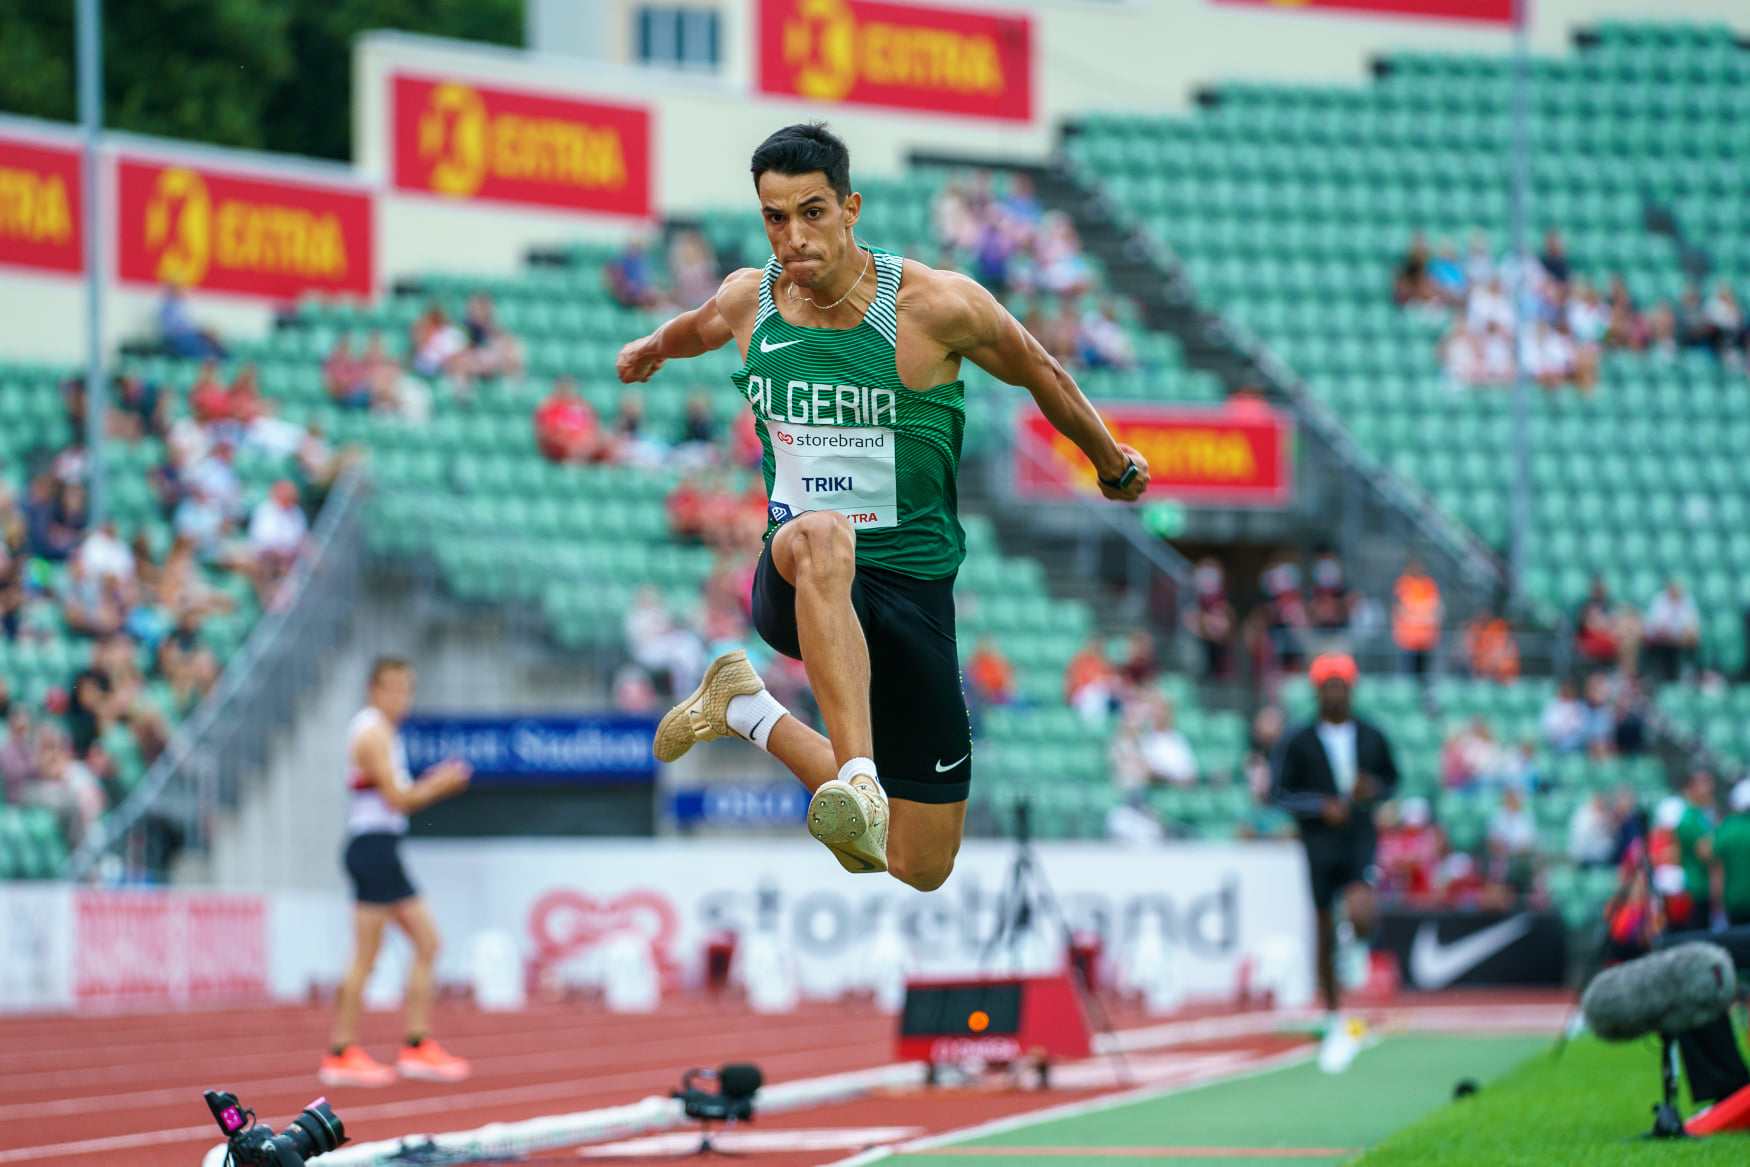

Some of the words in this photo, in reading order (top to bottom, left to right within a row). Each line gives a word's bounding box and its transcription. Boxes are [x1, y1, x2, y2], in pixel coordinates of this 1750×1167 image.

[859, 22, 1006, 97] EXTRA
[492, 112, 628, 192] EXTRA
[214, 199, 348, 281] EXTRA
[747, 374, 897, 426] ALGERIA
[796, 433, 884, 448] storebrand
[801, 476, 853, 492] TRIKI
